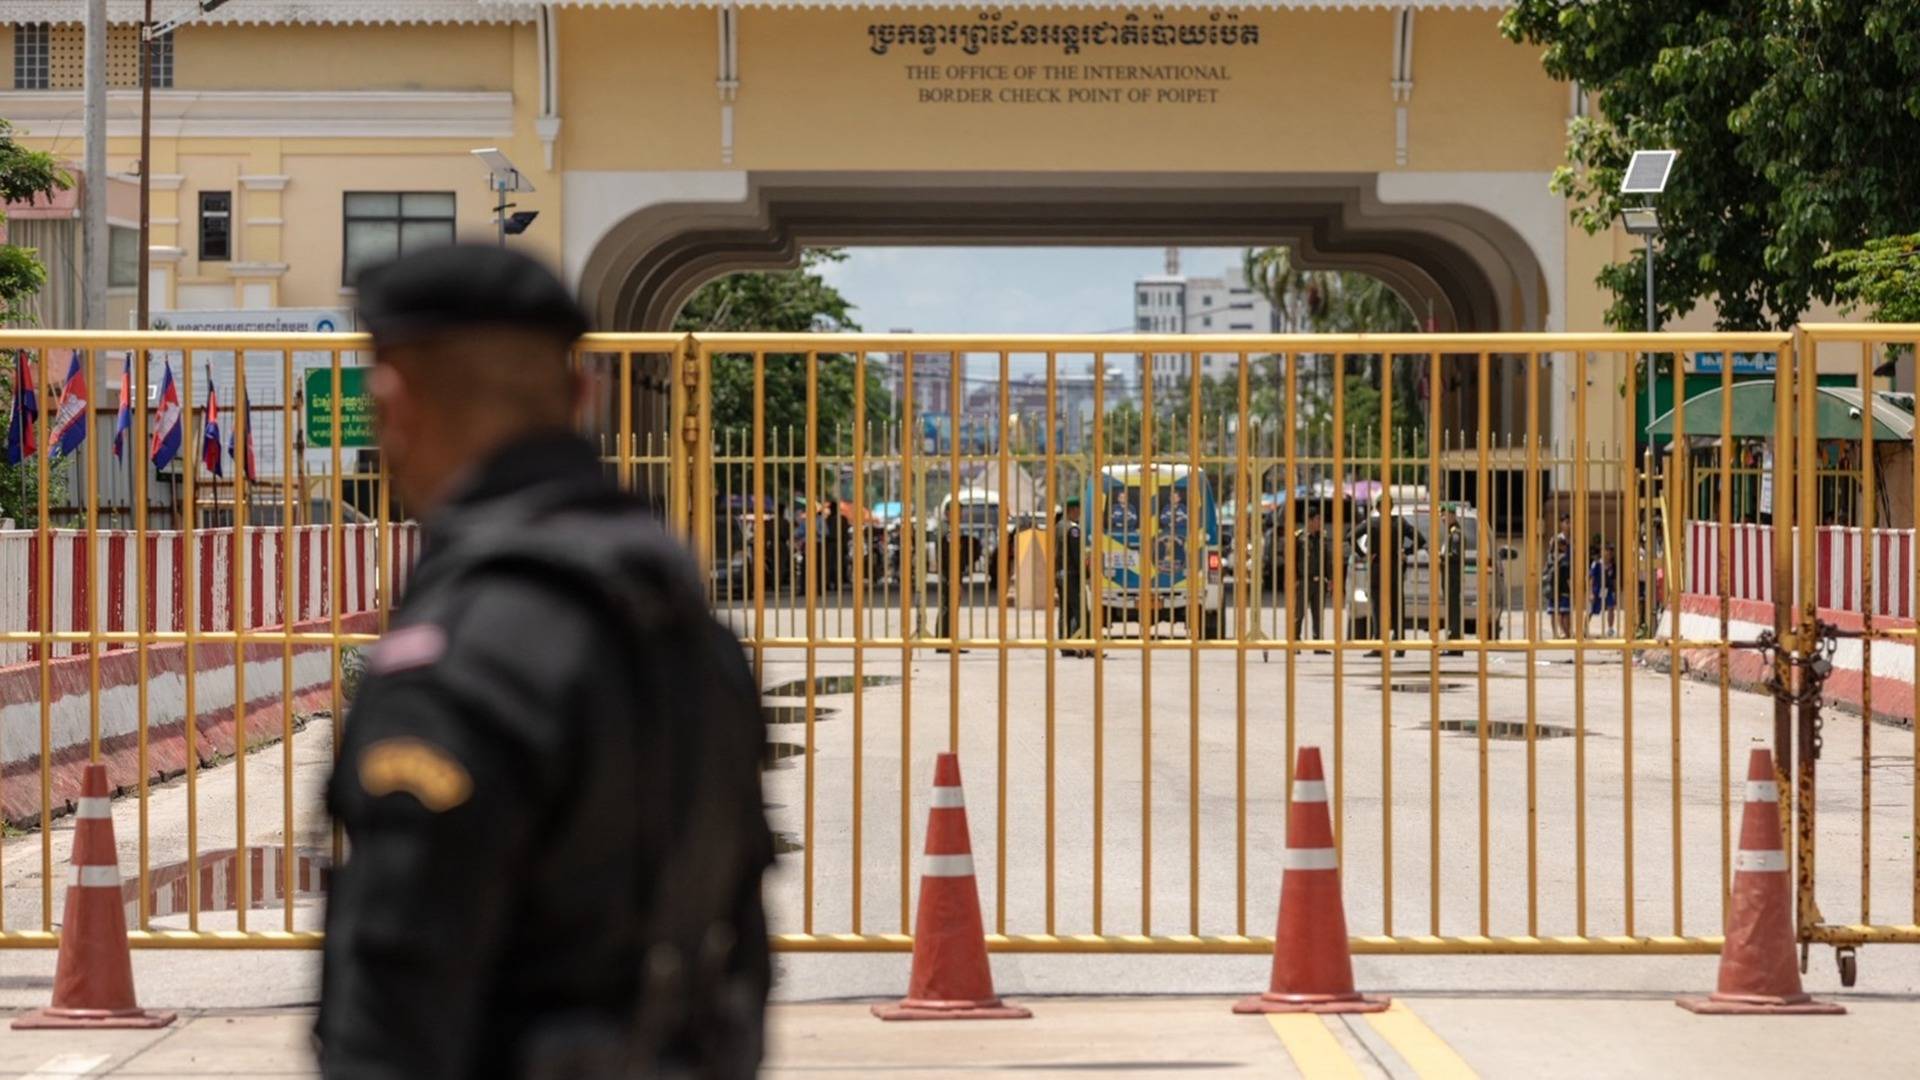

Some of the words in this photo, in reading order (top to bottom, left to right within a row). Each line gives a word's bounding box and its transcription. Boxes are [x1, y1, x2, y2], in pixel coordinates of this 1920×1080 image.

[905, 65, 940, 80] THE
[945, 65, 1008, 80] OFFICE
[1013, 65, 1037, 80] OF
[1042, 65, 1078, 80] THE
[1083, 65, 1231, 80] INTERNATIONAL
[918, 88, 993, 103] BORDER
[998, 88, 1062, 103] CHECK
[1068, 88, 1121, 103] POINT
[1127, 88, 1152, 103] OF
[1157, 88, 1219, 103] POIPET
